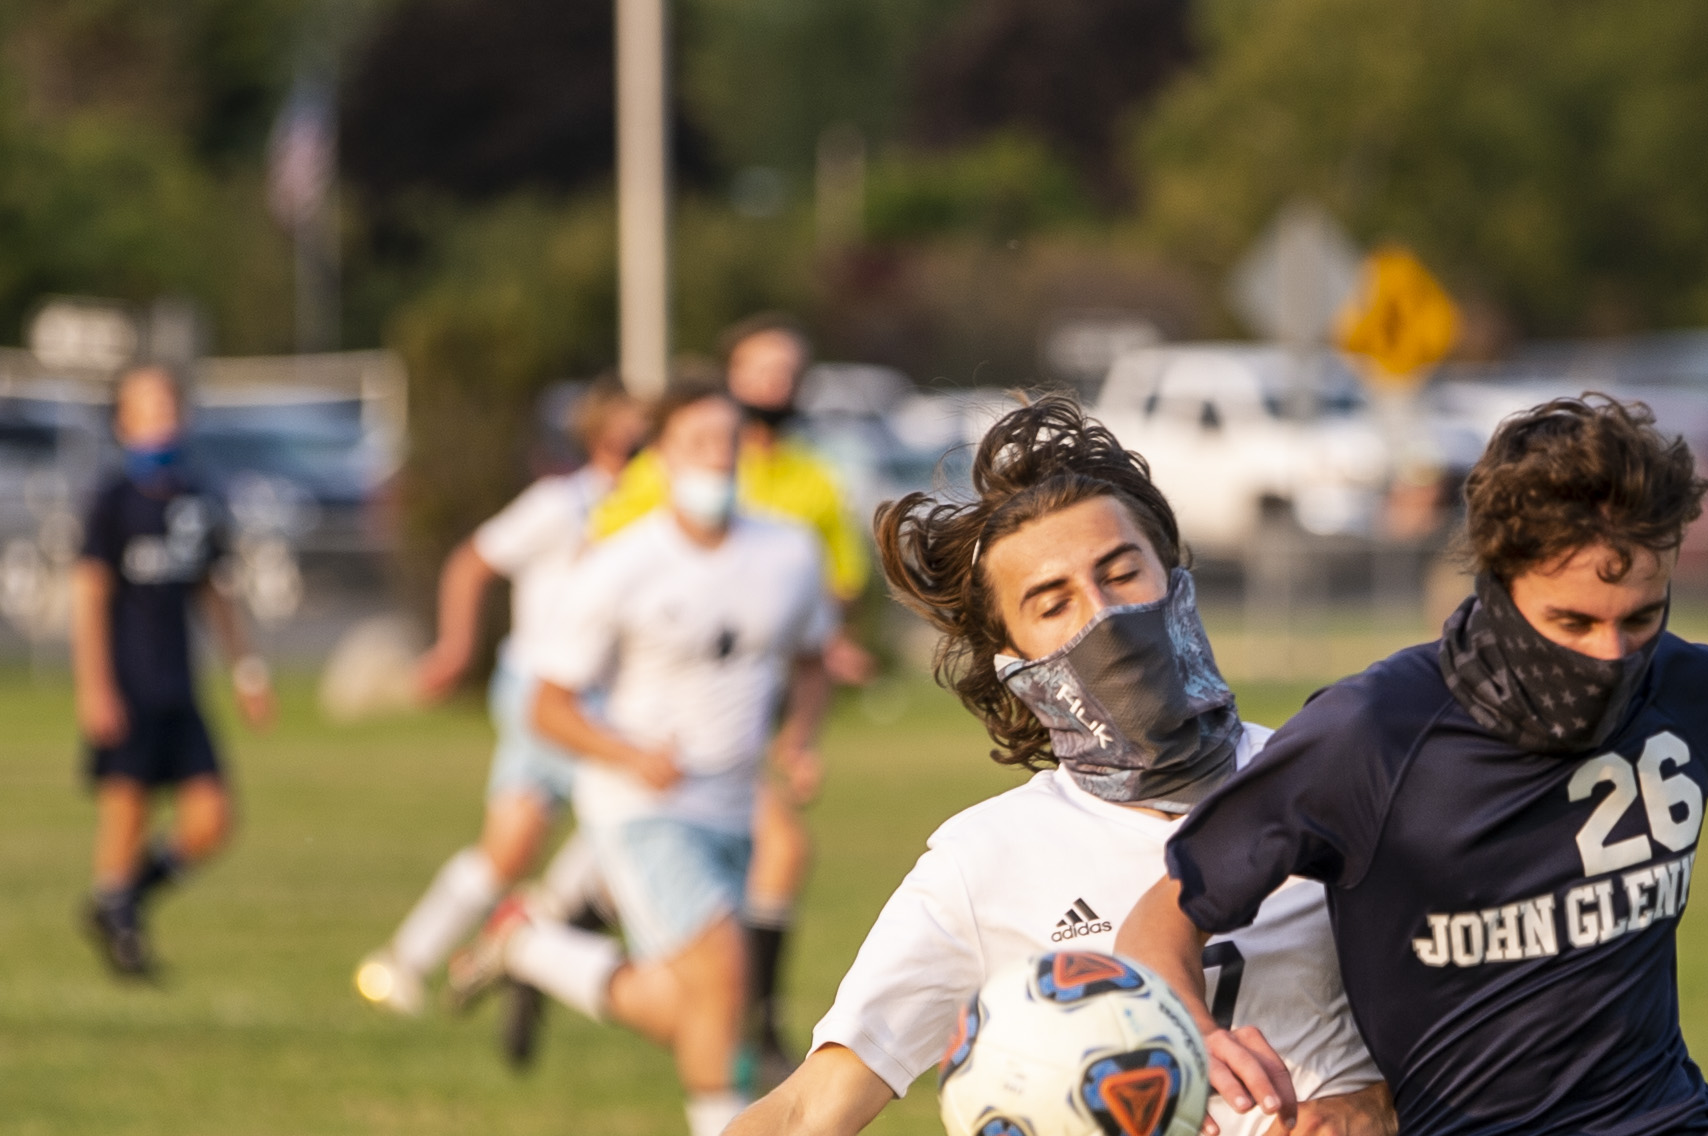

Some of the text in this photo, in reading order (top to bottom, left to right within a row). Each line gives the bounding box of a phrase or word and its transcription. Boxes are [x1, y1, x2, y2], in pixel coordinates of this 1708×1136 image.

[1056, 683, 1114, 750] HUK
[1567, 730, 1703, 878] 26
[1051, 920, 1112, 942] adidas
[1412, 893, 1558, 967] JOHN
